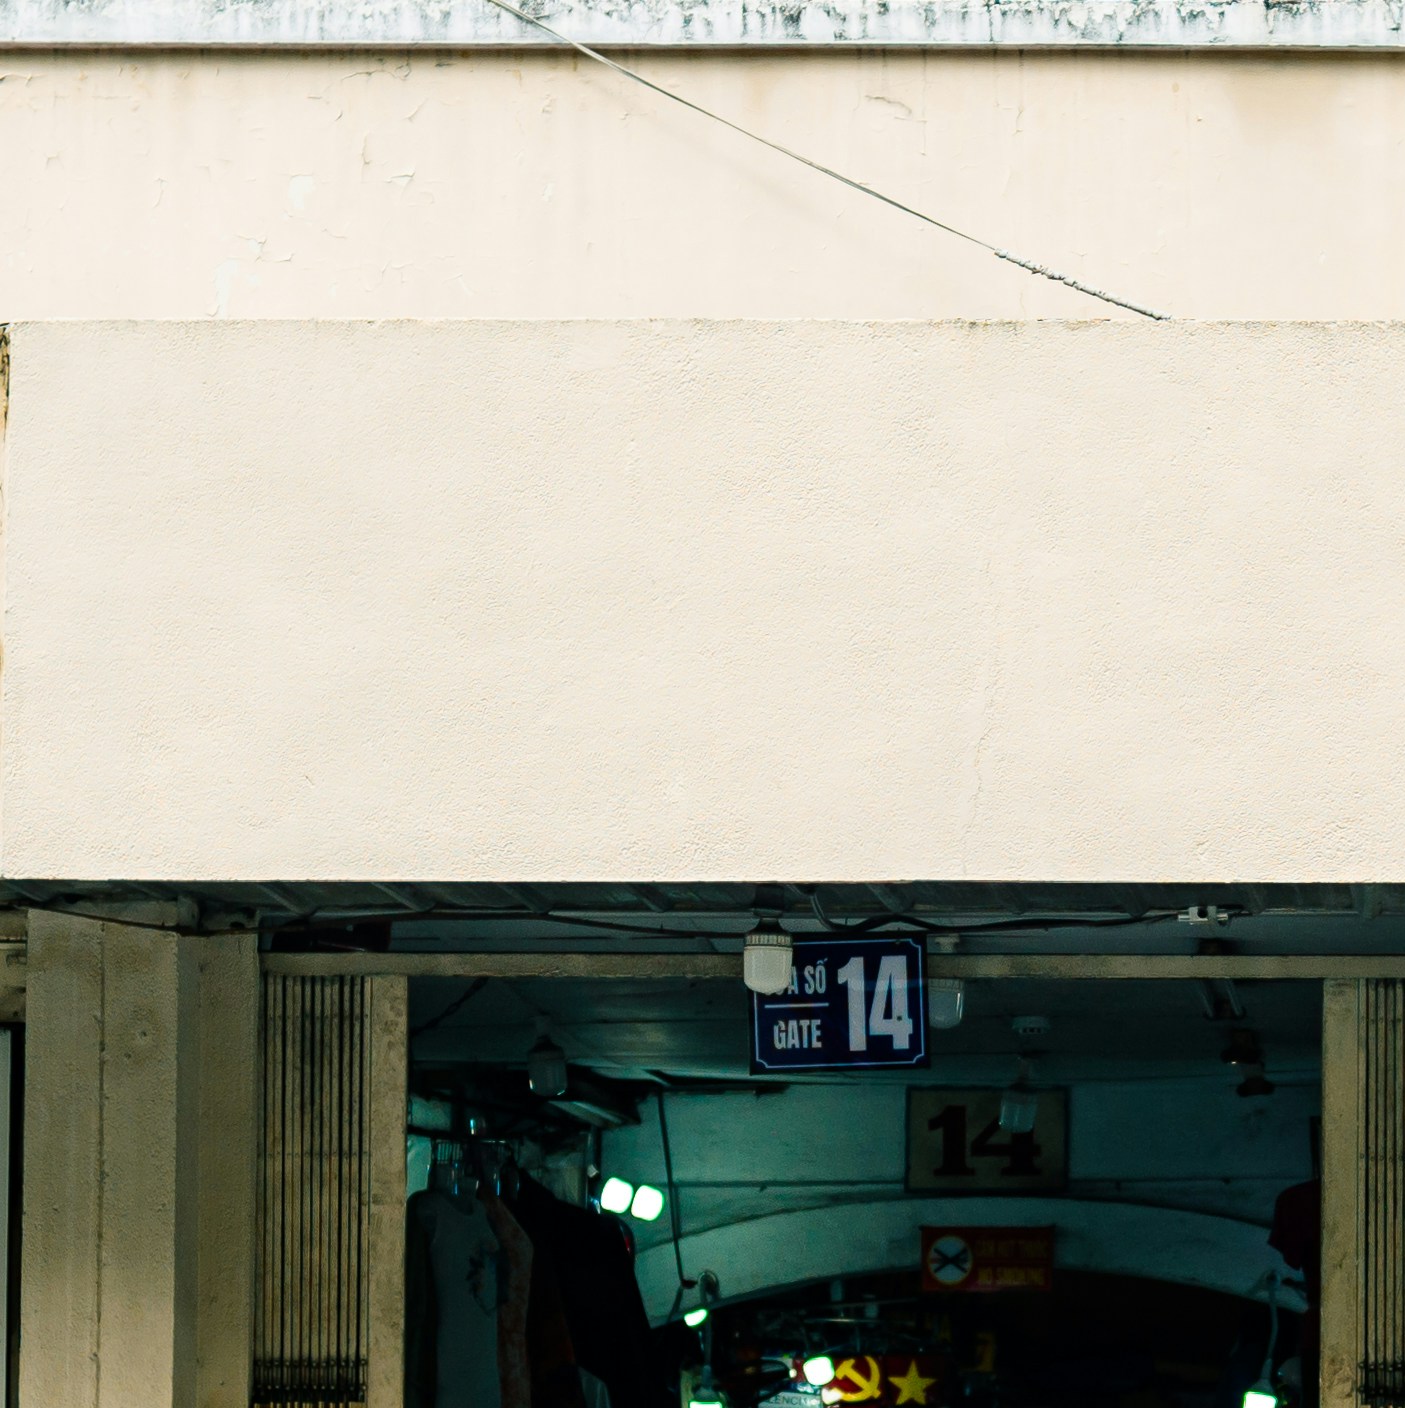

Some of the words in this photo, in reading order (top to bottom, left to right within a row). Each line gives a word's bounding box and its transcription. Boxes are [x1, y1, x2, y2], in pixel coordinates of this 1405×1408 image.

[773, 1018, 823, 1051] GATE
[837, 954, 913, 1052] 14
[926, 1104, 1043, 1178] 14
